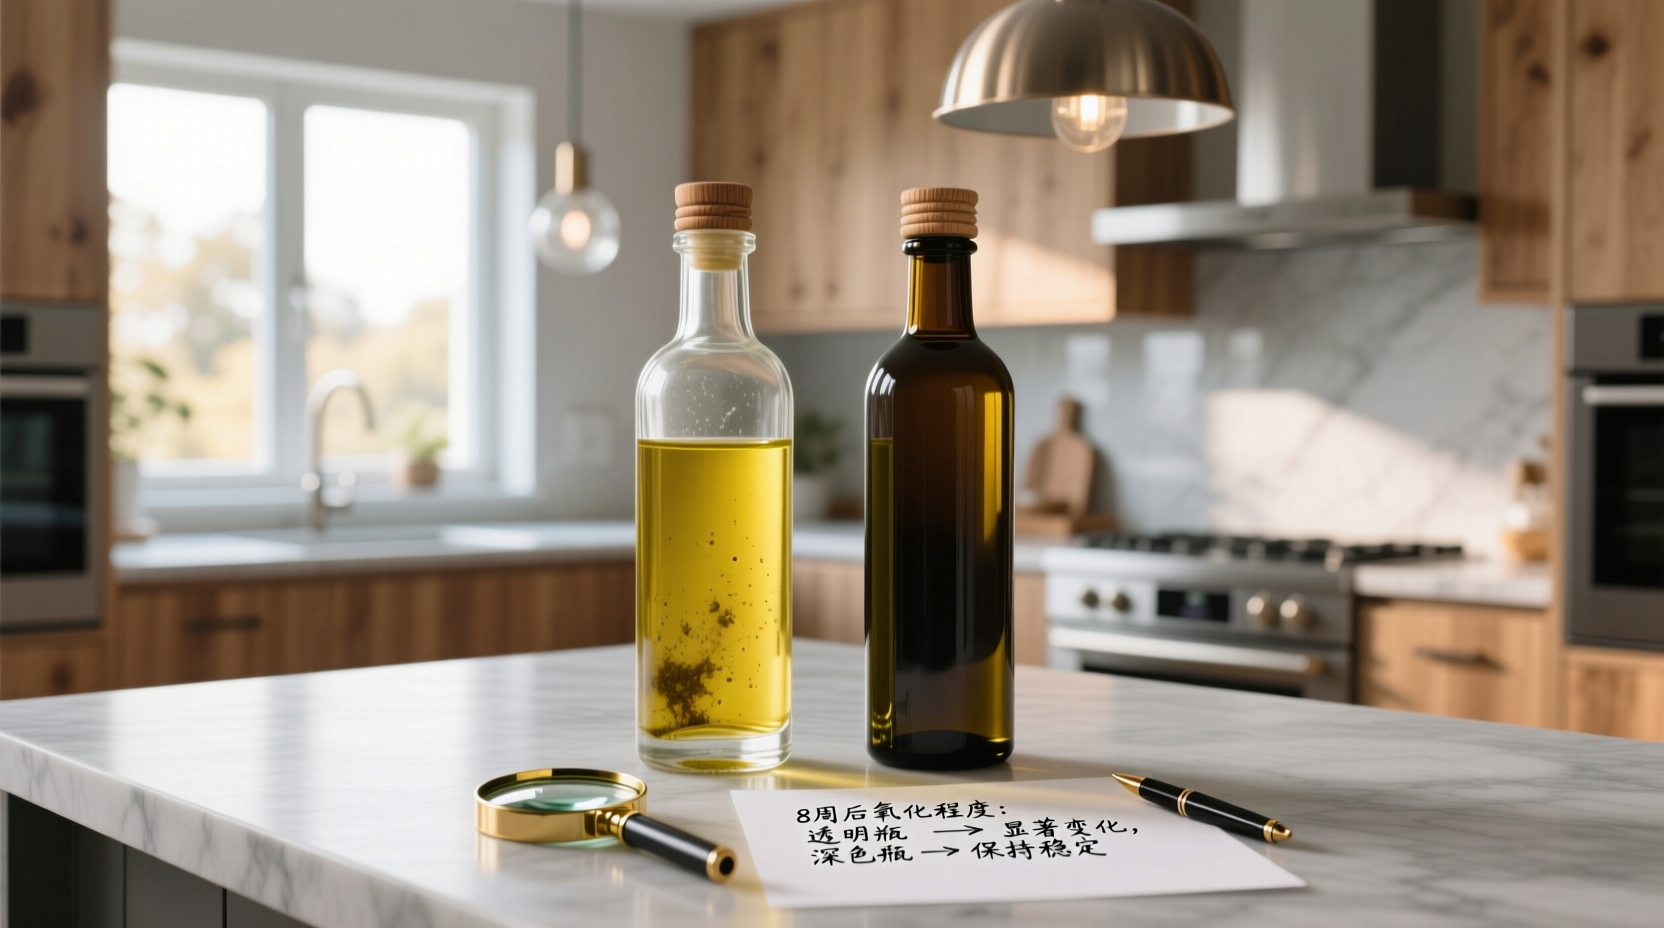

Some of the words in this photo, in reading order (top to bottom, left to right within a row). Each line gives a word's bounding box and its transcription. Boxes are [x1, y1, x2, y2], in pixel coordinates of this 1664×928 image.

[796, 800, 1006, 823] 8周后氧化程度：
[808, 825, 908, 845] 透明瓶
[1003, 818, 1139, 839] 显著变化，
[811, 845, 914, 867] 深色瓶
[971, 838, 1107, 860] 保持稳定
